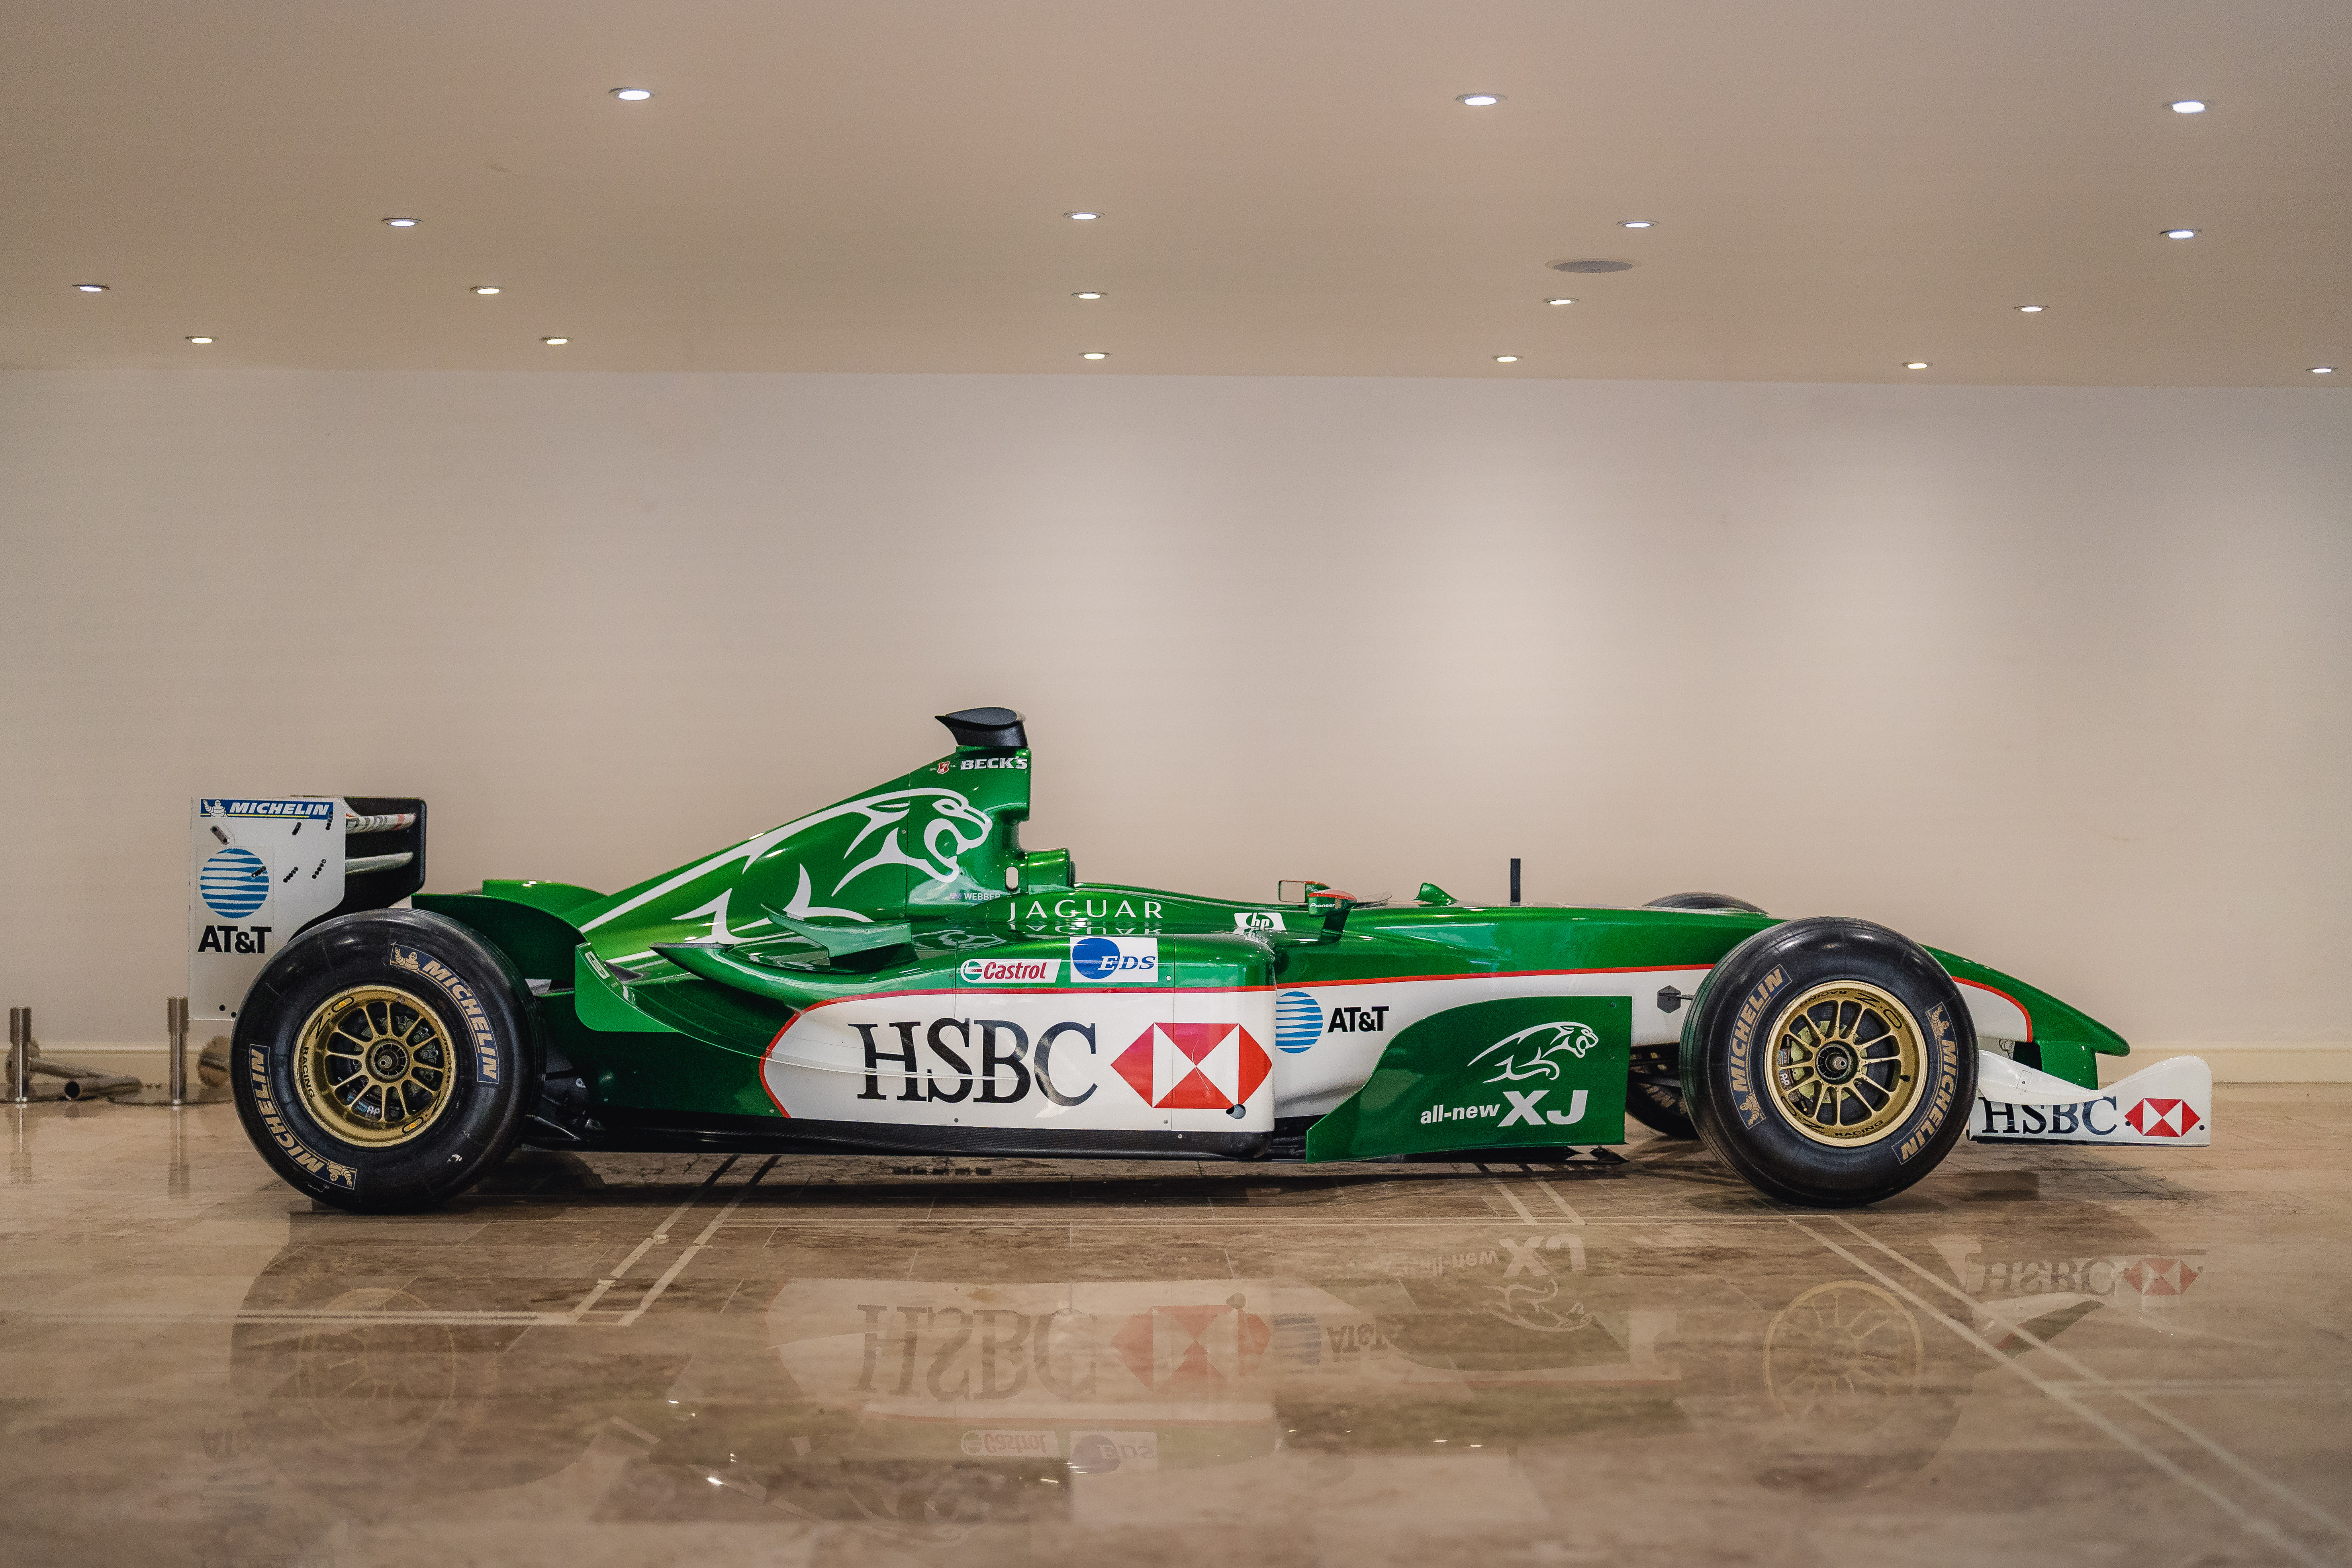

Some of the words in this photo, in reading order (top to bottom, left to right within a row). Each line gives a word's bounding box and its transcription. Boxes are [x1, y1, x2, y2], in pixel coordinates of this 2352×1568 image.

[960, 756, 1028, 770] BECK'S
[229, 802, 330, 816] MICHELIN
[1007, 899, 1163, 922] JAGUAR
[1250, 912, 1270, 930] hp
[197, 925, 272, 954] AT&T
[983, 961, 1047, 980] Castrol
[1097, 956, 1156, 971] EDS
[422, 959, 497, 1079] MICHELIN
[1328, 1006, 1390, 1033] AT&T
[1731, 967, 1785, 1094] MICHELIN
[302, 1046, 315, 1098] RACING
[847, 1017, 1098, 1107] HSBC
[251, 1048, 326, 1174] MICHELIN
[1420, 1103, 1500, 1124] all-new
[1498, 1089, 1588, 1127] XJ
[1901, 1040, 1957, 1161] MICHELIN
[1835, 1120, 1884, 1136] RACING
[1978, 1096, 2118, 1135] HSBC
